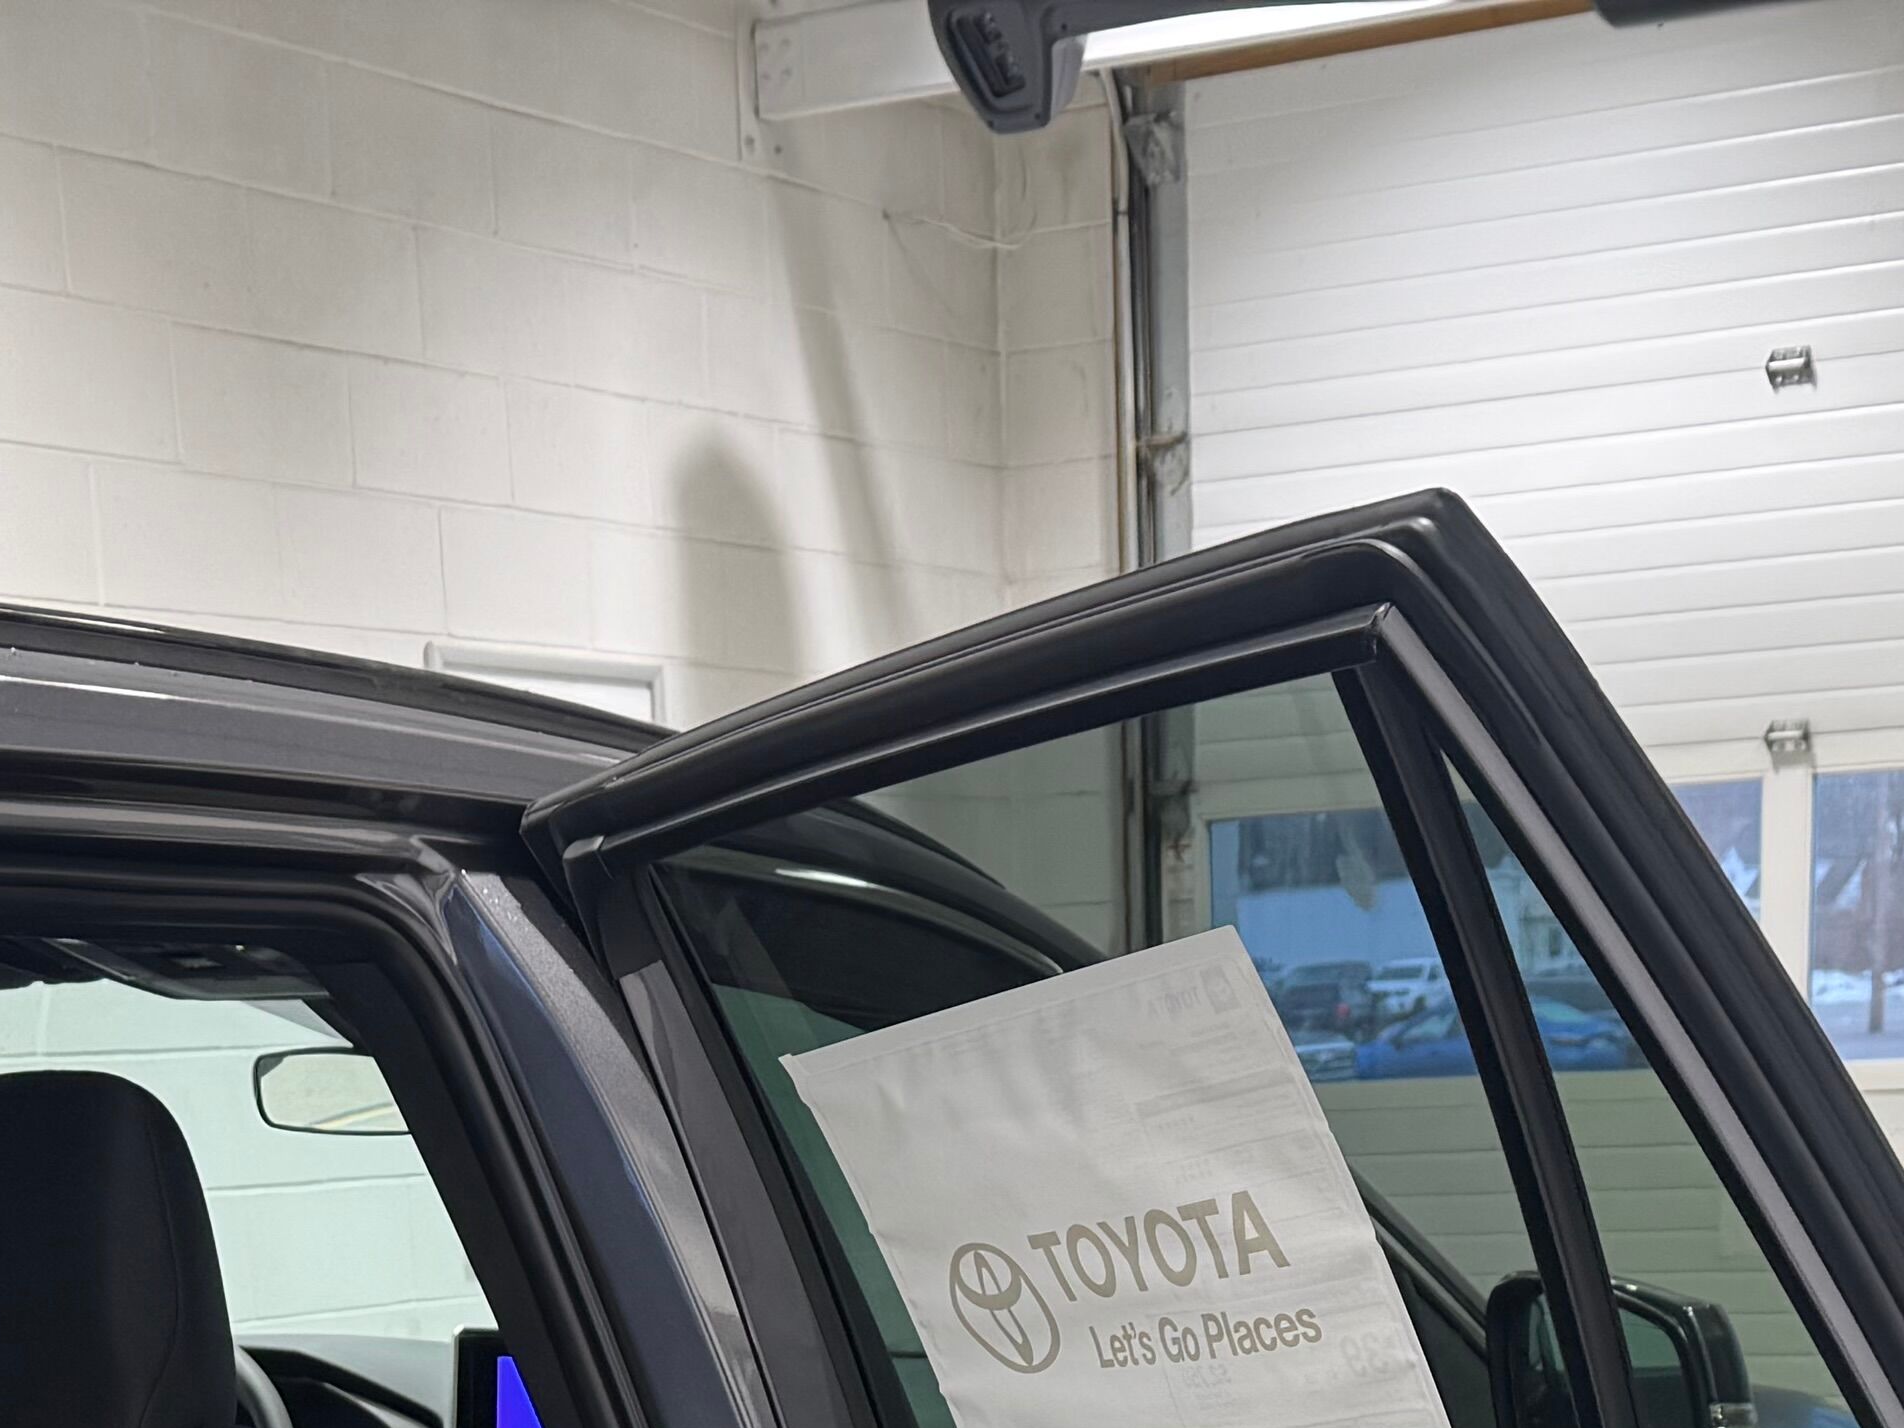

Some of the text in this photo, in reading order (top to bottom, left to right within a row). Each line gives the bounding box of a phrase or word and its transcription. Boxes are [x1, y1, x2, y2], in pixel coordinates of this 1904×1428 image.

[1027, 1190, 1291, 1303] TOYOTA
[1089, 1304, 1323, 1370] Let's Go Places
